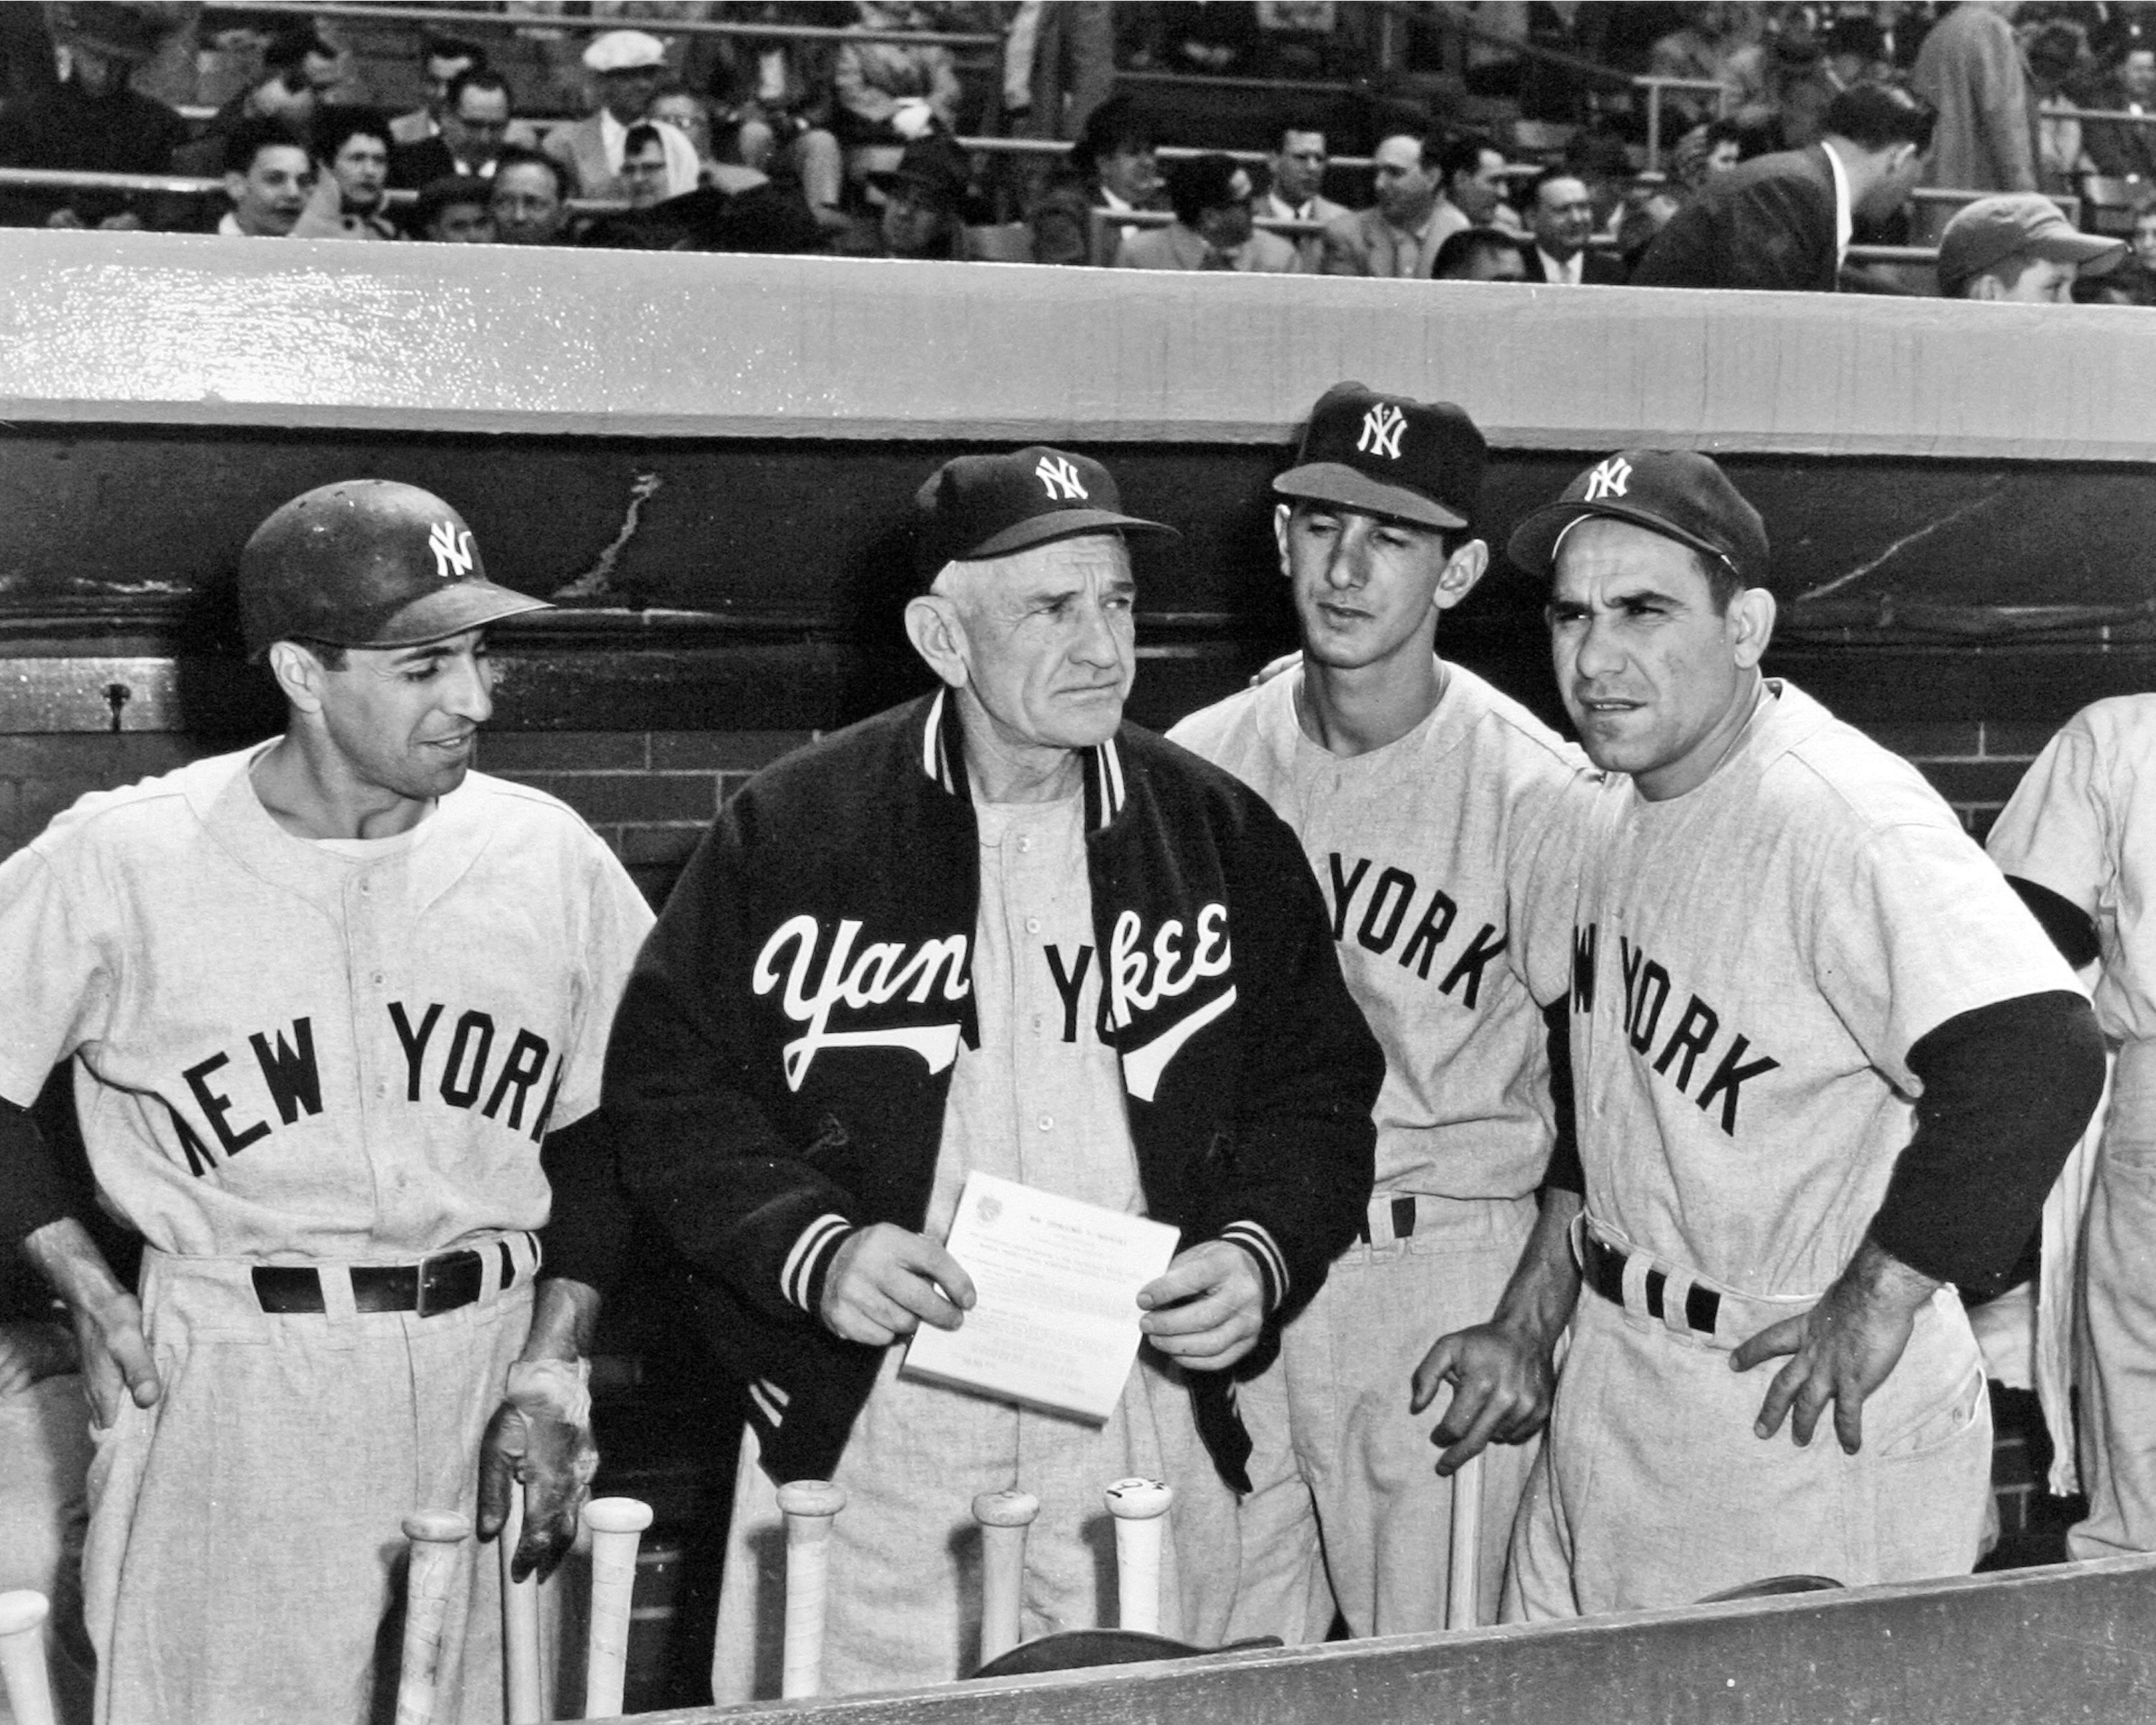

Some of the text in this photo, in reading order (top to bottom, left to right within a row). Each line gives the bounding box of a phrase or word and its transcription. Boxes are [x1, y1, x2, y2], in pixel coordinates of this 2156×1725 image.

[1356, 402, 1408, 460] NY
[1035, 456, 1089, 500] NY
[1583, 457, 1633, 502] NY
[428, 520, 473, 576] NY
[1330, 852, 1508, 1010] YORK
[1620, 935, 1781, 1137] YORK
